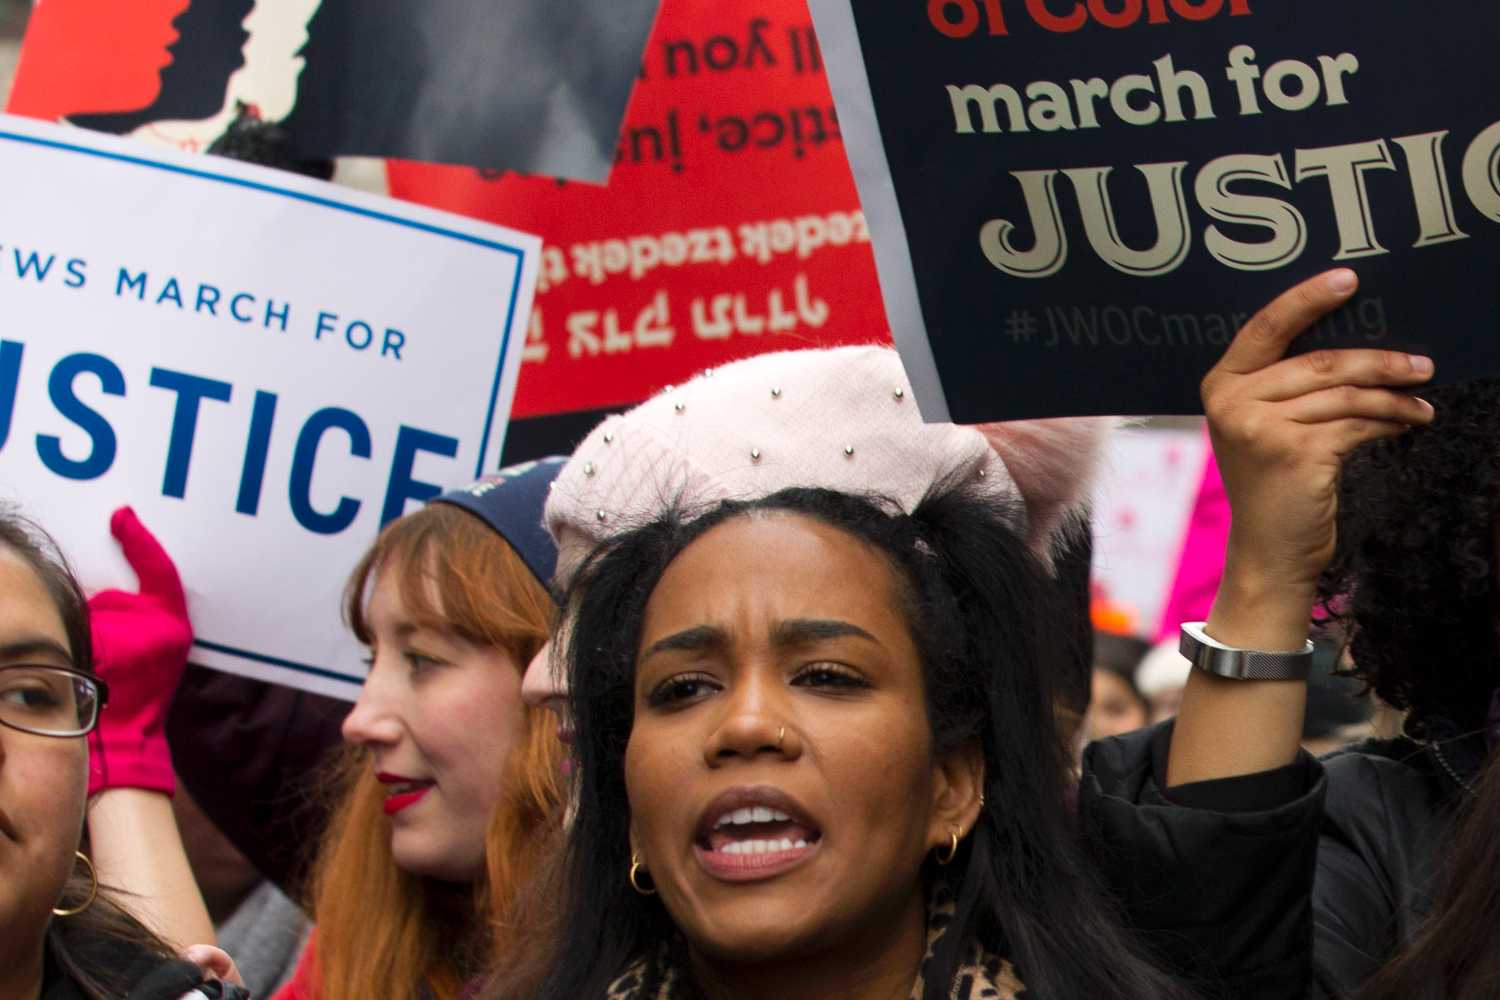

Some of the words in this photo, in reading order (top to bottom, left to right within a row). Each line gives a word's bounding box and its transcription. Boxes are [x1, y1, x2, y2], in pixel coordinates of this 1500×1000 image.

[665, 18, 776, 78] you
[945, 52, 1217, 134] march
[1226, 44, 1359, 115] for
[571, 226, 735, 286] tzedek
[0, 243, 88, 289] WS
[114, 267, 291, 332] MARCH
[313, 311, 407, 360] FOR
[565, 290, 676, 358] צדק
